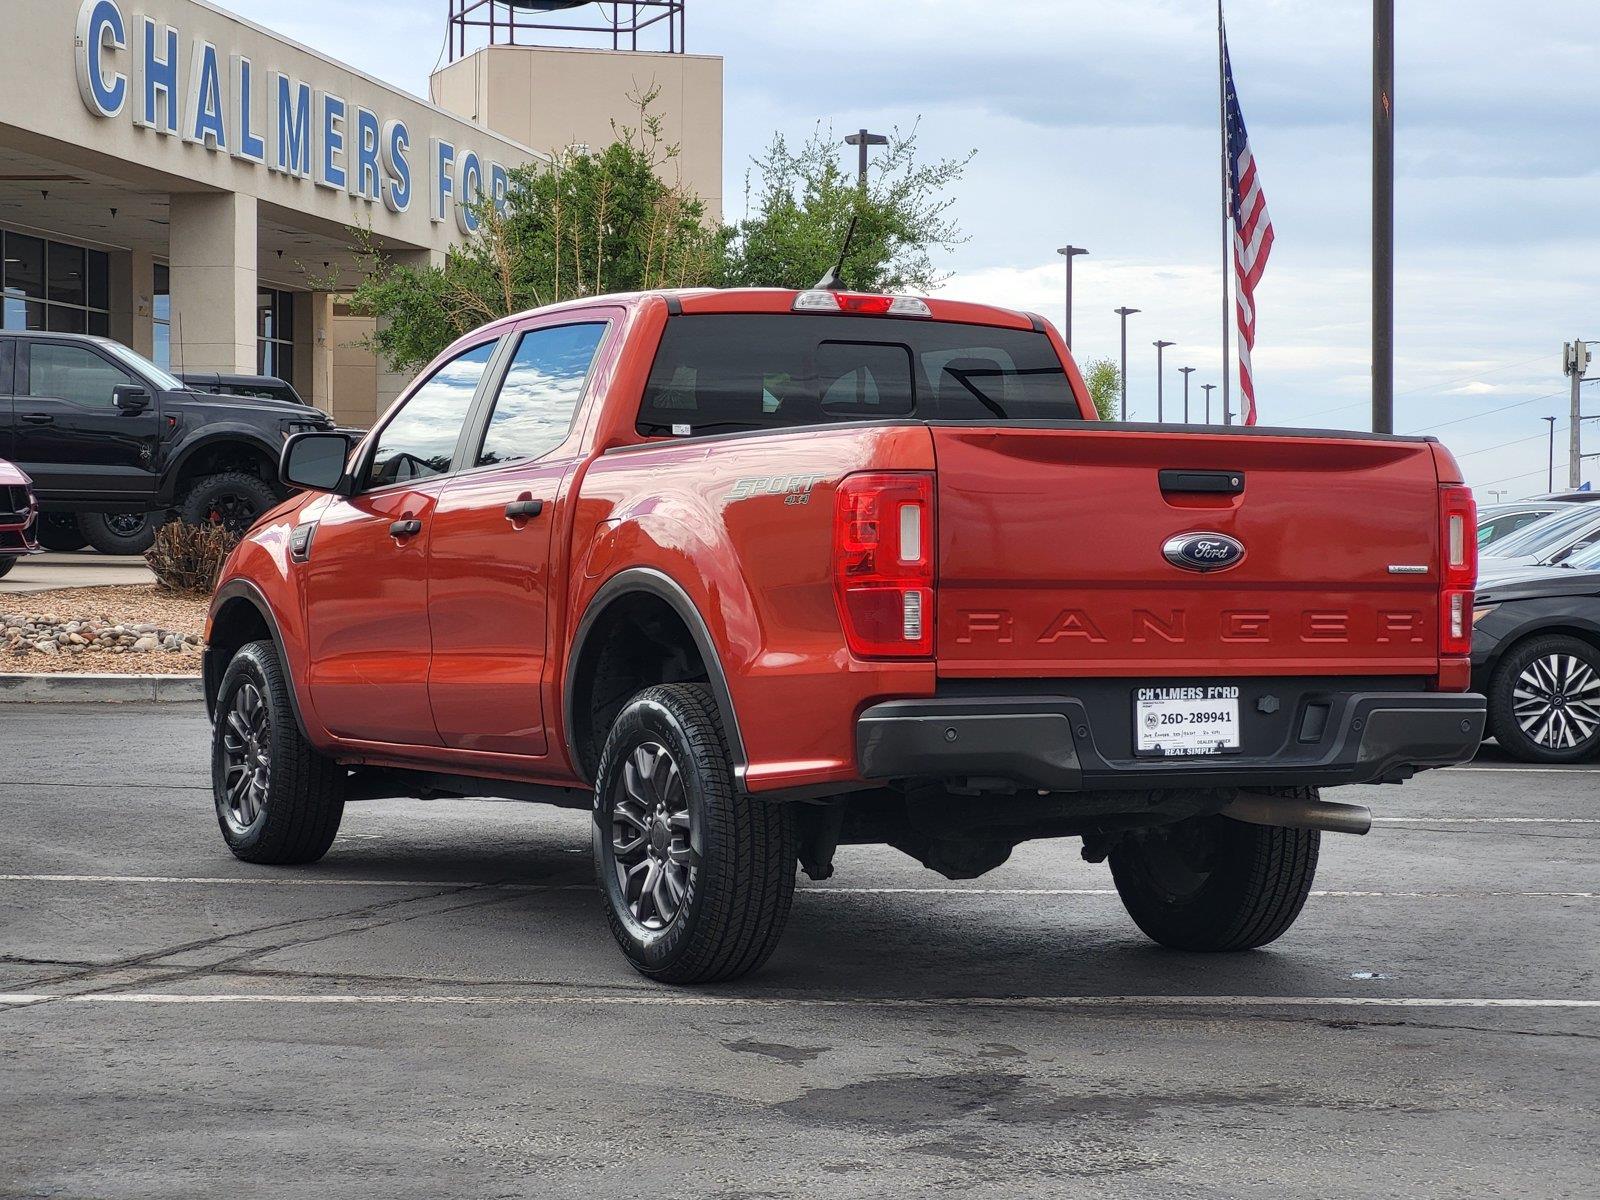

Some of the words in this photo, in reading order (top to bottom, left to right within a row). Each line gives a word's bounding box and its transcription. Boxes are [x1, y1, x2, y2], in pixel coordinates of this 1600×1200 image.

[75, 0, 412, 214] CHALMERS
[429, 137, 527, 236] FOR
[723, 473, 825, 499] SPORT
[1194, 541, 1229, 560] Ford
[955, 608, 1424, 644] RANGER
[1160, 712, 1232, 725] 26D-289941
[1164, 748, 1185, 756] REAL
